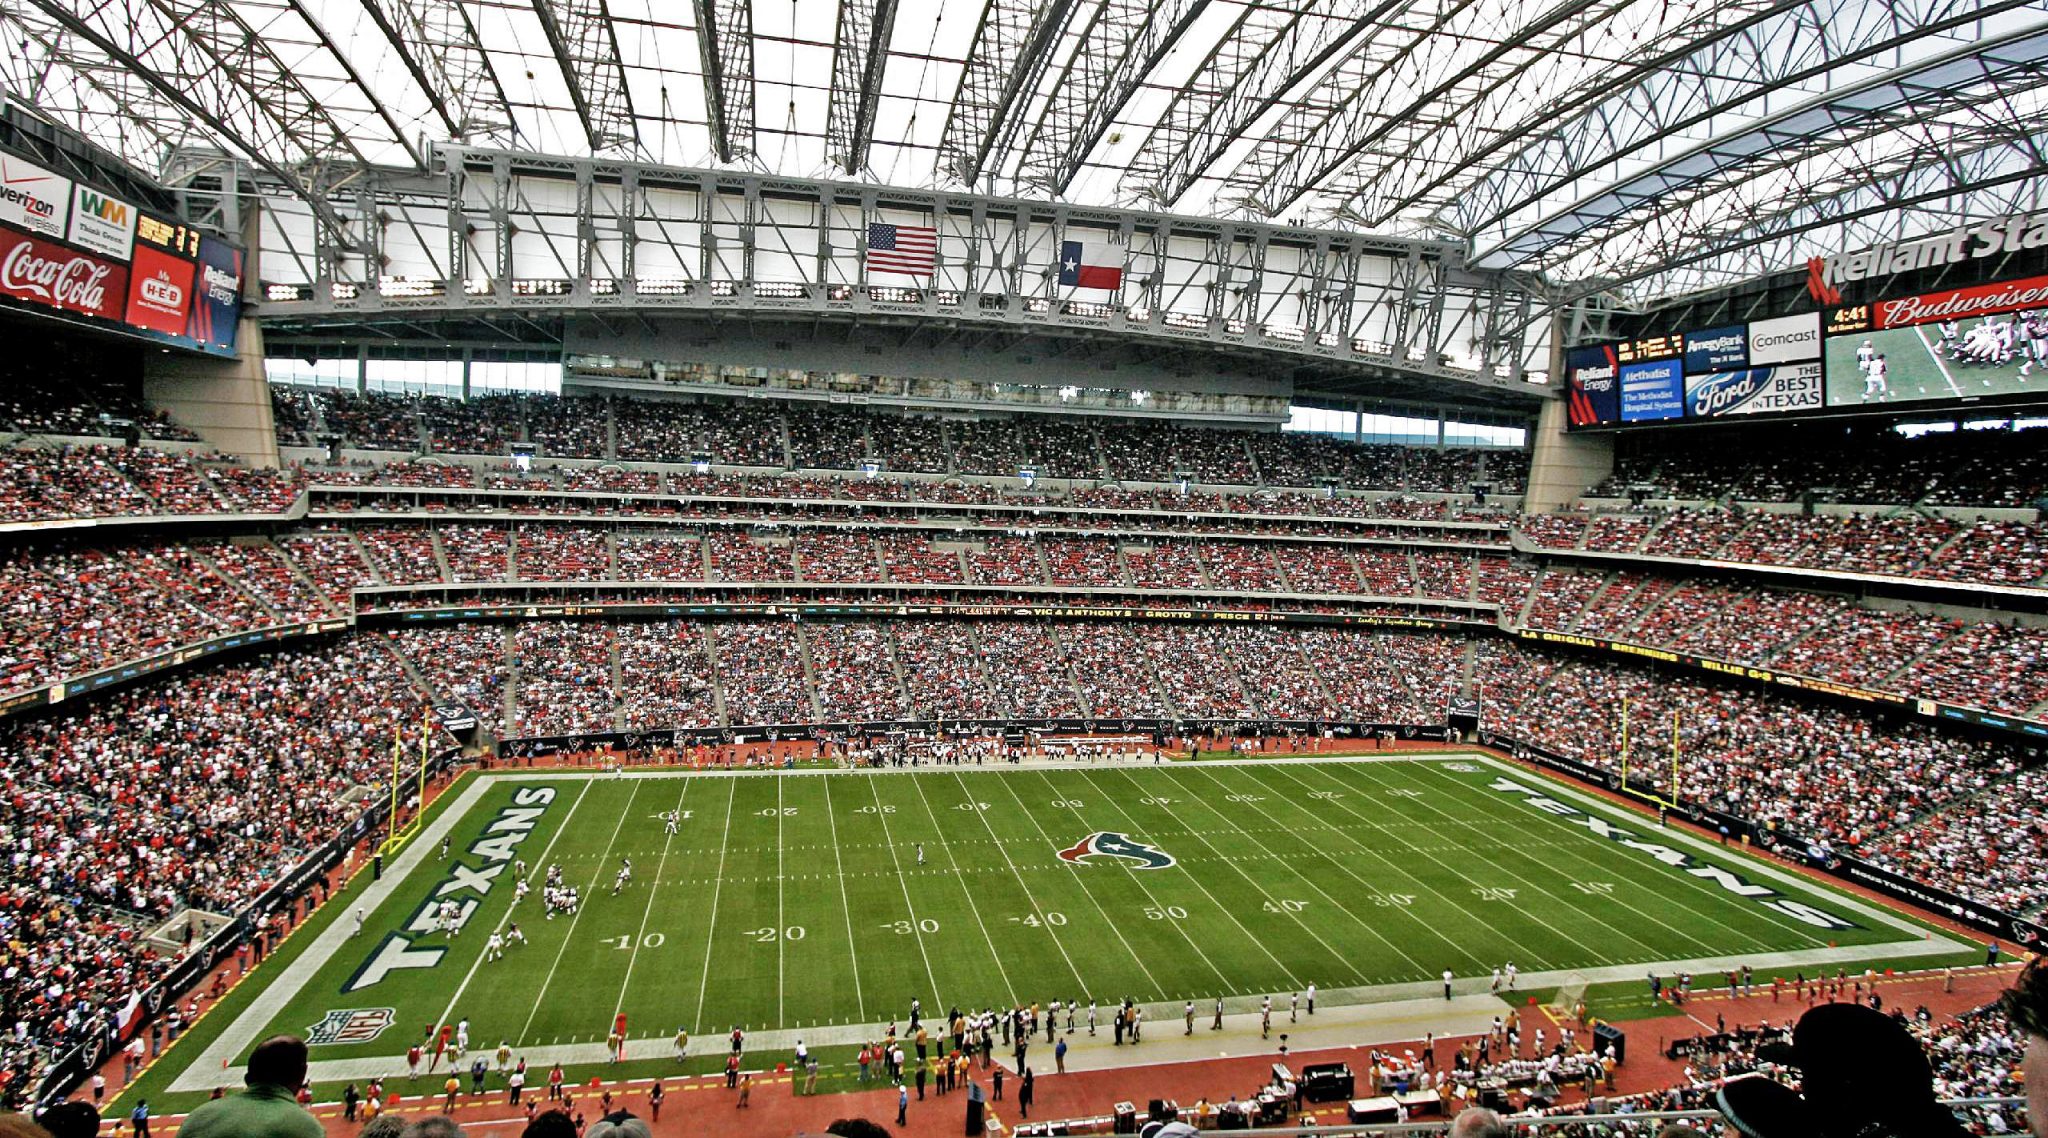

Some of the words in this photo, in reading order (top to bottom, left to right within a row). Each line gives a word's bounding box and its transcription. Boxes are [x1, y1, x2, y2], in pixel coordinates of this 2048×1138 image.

[0, 185, 54, 217] verizon
[81, 190, 127, 227] WM
[1821, 227, 1969, 288] Reliant
[1, 241, 111, 312] Coca-Cola
[203, 265, 240, 291] Reliant
[147, 284, 178, 302] H-E-B
[208, 284, 236, 307] Energy
[1834, 305, 1868, 322] 4:41
[1884, 287, 2048, 325] Budweiser
[1687, 334, 1745, 354] AmegyBank
[1576, 365, 1615, 382] Reliant
[1583, 379, 1611, 392] Energy
[1775, 375, 1820, 391] BEST
[1695, 371, 1755, 415] Ford
[1752, 401, 1762, 409] IN
[1763, 391, 1820, 408] TEXAS
[1521, 631, 1538, 640] LA
[1701, 660, 1744, 676] WILLIE
[1487, 776, 1860, 930] TEXANS
[341, 785, 557, 994] TEXANS
[1471, 886, 1512, 902] 20
[1261, 899, 1302, 914] 40
[1367, 892, 1409, 909] 30
[1018, 911, 1068, 929] 40
[1143, 905, 1188, 921] 50
[756, 925, 807, 943] 20
[894, 918, 940, 935] 30
[612, 932, 666, 950] 10
